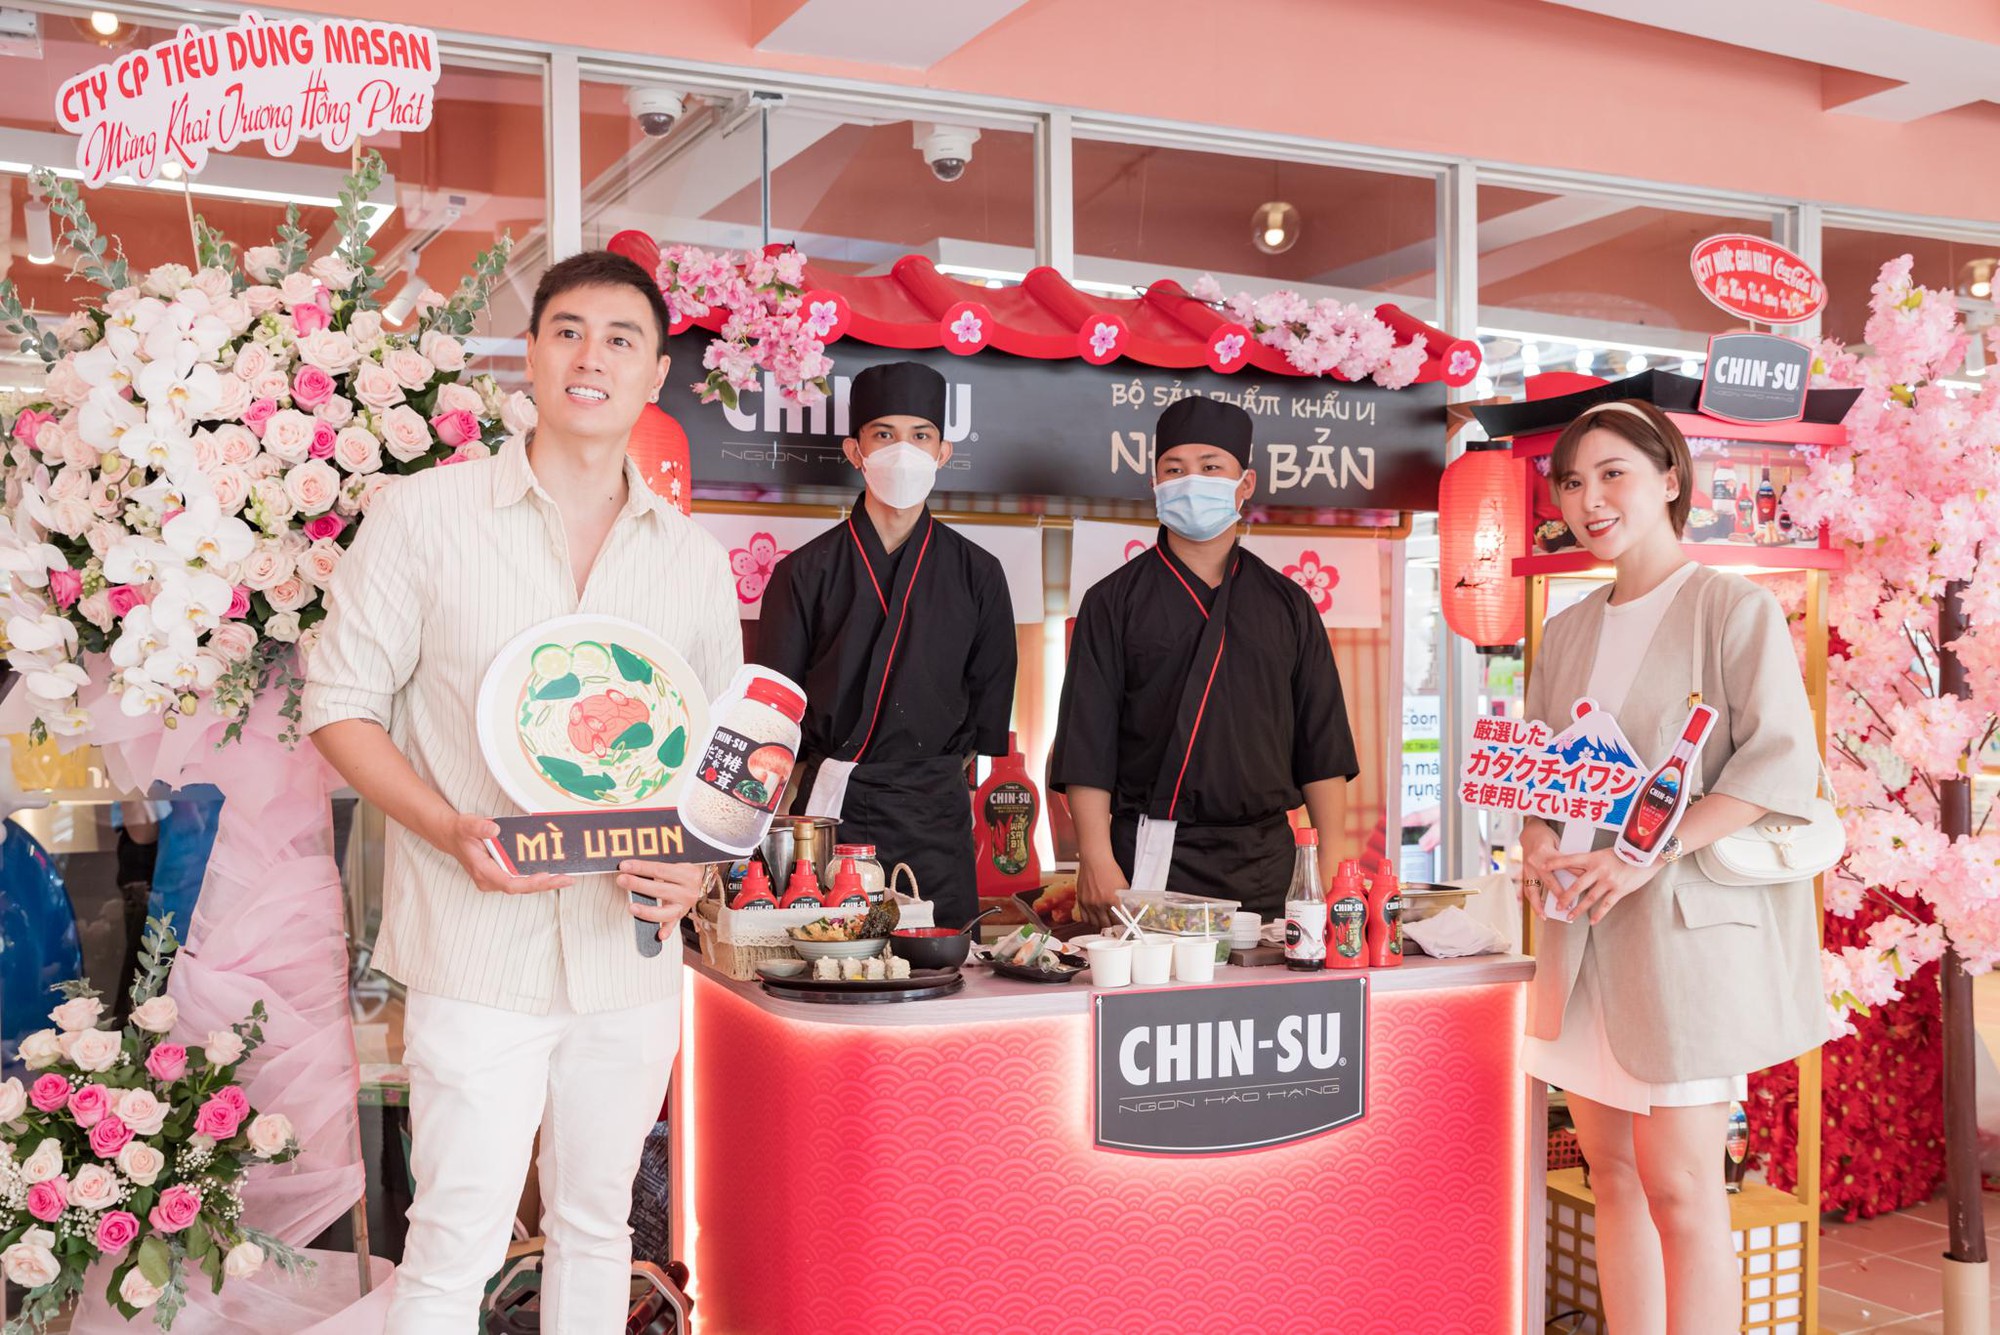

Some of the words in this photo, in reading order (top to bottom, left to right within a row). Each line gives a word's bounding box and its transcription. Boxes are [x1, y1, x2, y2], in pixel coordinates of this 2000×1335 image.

[62, 74, 107, 123] CTY
[117, 62, 150, 99] CP
[157, 28, 219, 87] TIÊU
[228, 15, 315, 68] DÙNG
[324, 24, 432, 72] MASAN
[84, 120, 157, 181] Mừng
[164, 92, 211, 170] Khai
[300, 68, 352, 146] Hồng
[357, 79, 425, 130] Phát
[1714, 356, 1800, 391] CHIN-SU
[1111, 379, 1145, 410] BỘ
[1291, 391, 1350, 420] KHẨU
[1356, 401, 1376, 426] VỊ
[721, 449, 808, 463] NGON
[1267, 427, 1375, 495] BẢN
[715, 731, 748, 752] CHIN-SU
[1473, 718, 1546, 748] 厳選した
[1467, 748, 1637, 795] カタクチイワシ
[990, 793, 1031, 804] CHIN-SU
[1462, 782, 1609, 822] を使用しています
[516, 822, 565, 862] MÌ
[583, 825, 685, 860] UDON
[1119, 1012, 1341, 1086] CHIN-SU
[1118, 1099, 1195, 1114] NGON
